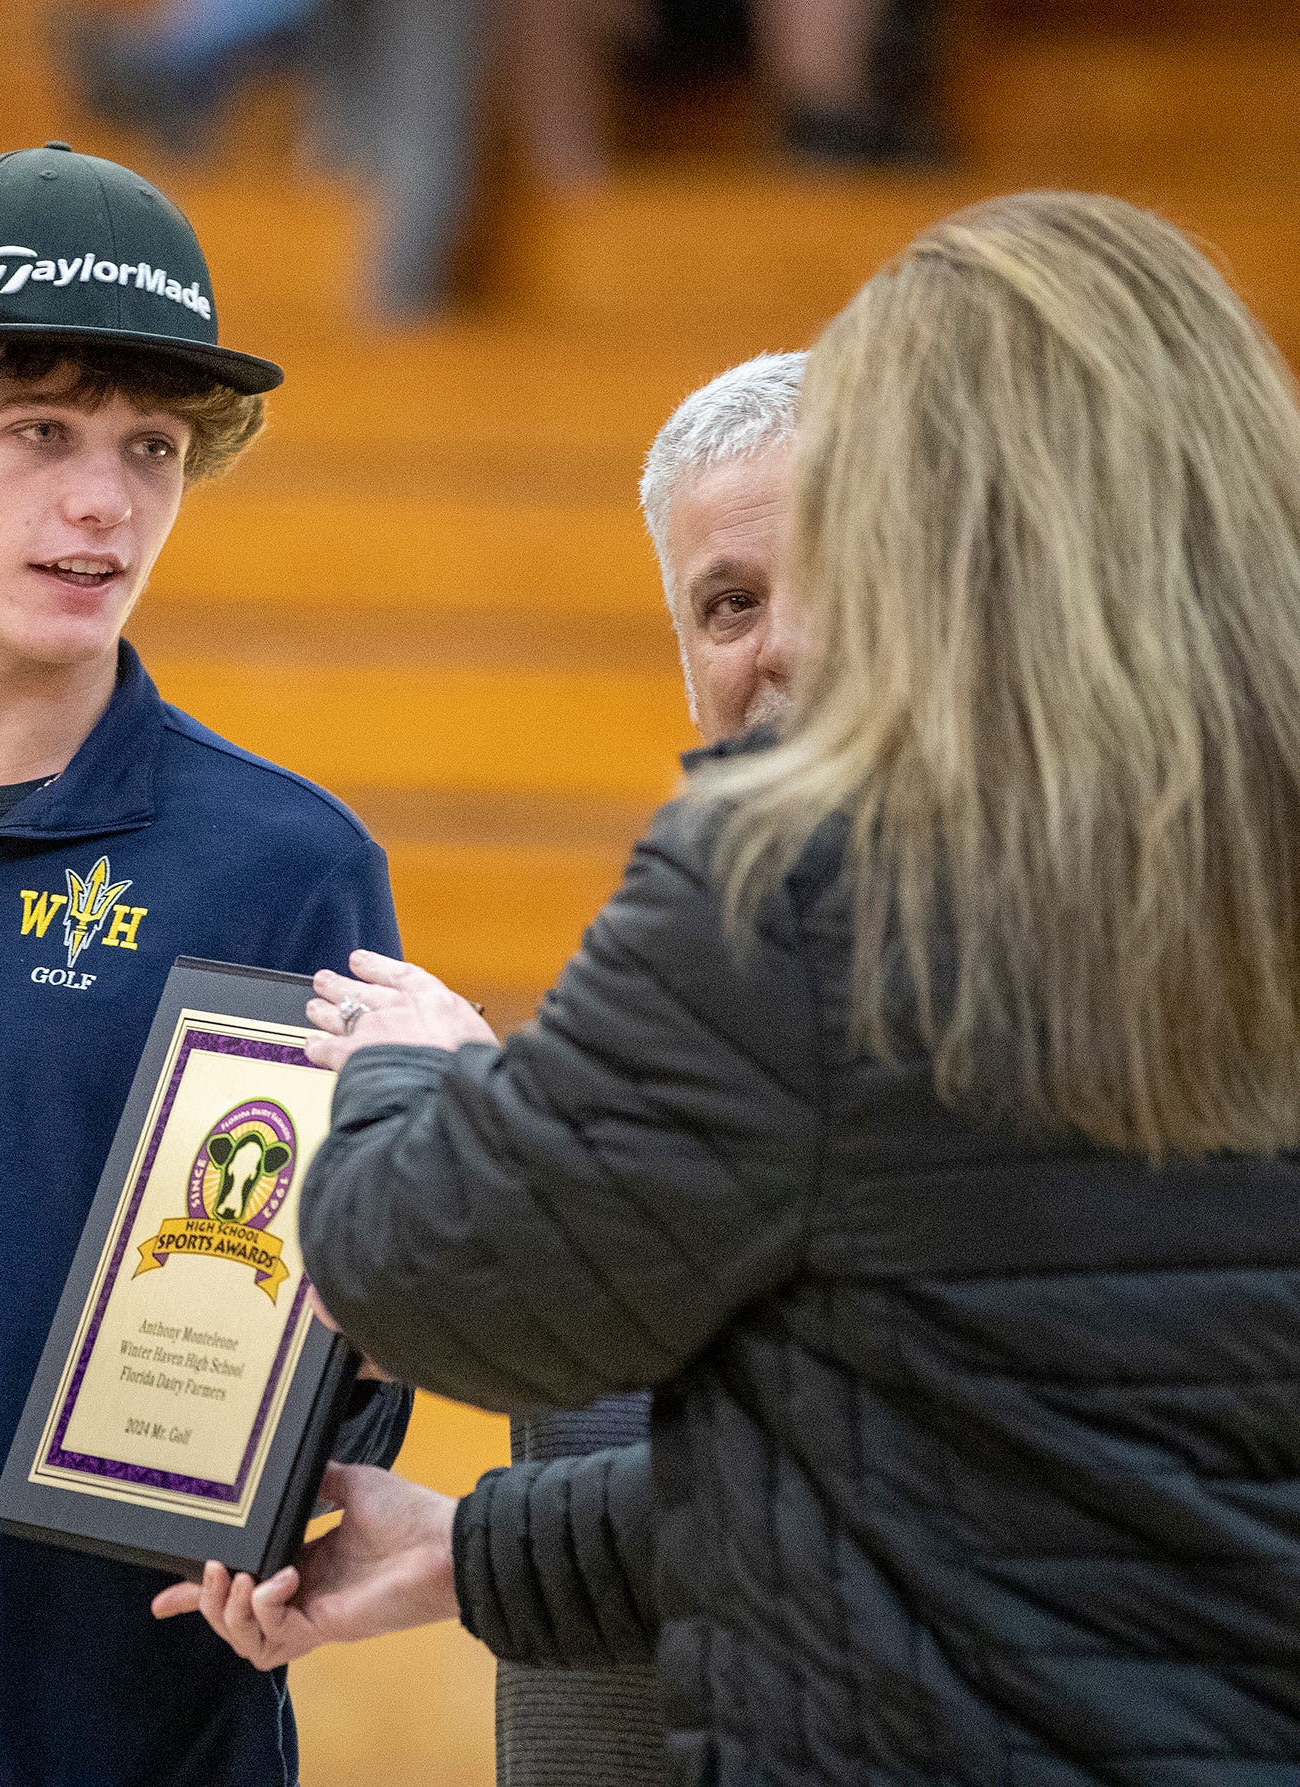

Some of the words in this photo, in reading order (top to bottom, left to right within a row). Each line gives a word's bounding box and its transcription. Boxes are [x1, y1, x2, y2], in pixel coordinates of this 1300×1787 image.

[31, 966, 98, 990] GOLF
[190, 1159, 207, 1208] SINCE
[186, 1221, 215, 1233] HIGH
[217, 1223, 259, 1243] SCHOOL
[158, 1234, 213, 1250] SPORTS
[214, 1239, 276, 1268] AWARDS
[138, 1319, 181, 1343] Anthony
[183, 1326, 239, 1351] Monteleone
[120, 1339, 151, 1359] Winter
[152, 1348, 184, 1367] Haven
[185, 1352, 209, 1372] High
[210, 1357, 245, 1378] School
[120, 1365, 155, 1388] Florida
[155, 1372, 185, 1396] Dairy
[185, 1378, 227, 1401] Farmers
[124, 1417, 150, 1436] 2024
[150, 1422, 166, 1440] Mr.
[168, 1426, 193, 1445] Golf
